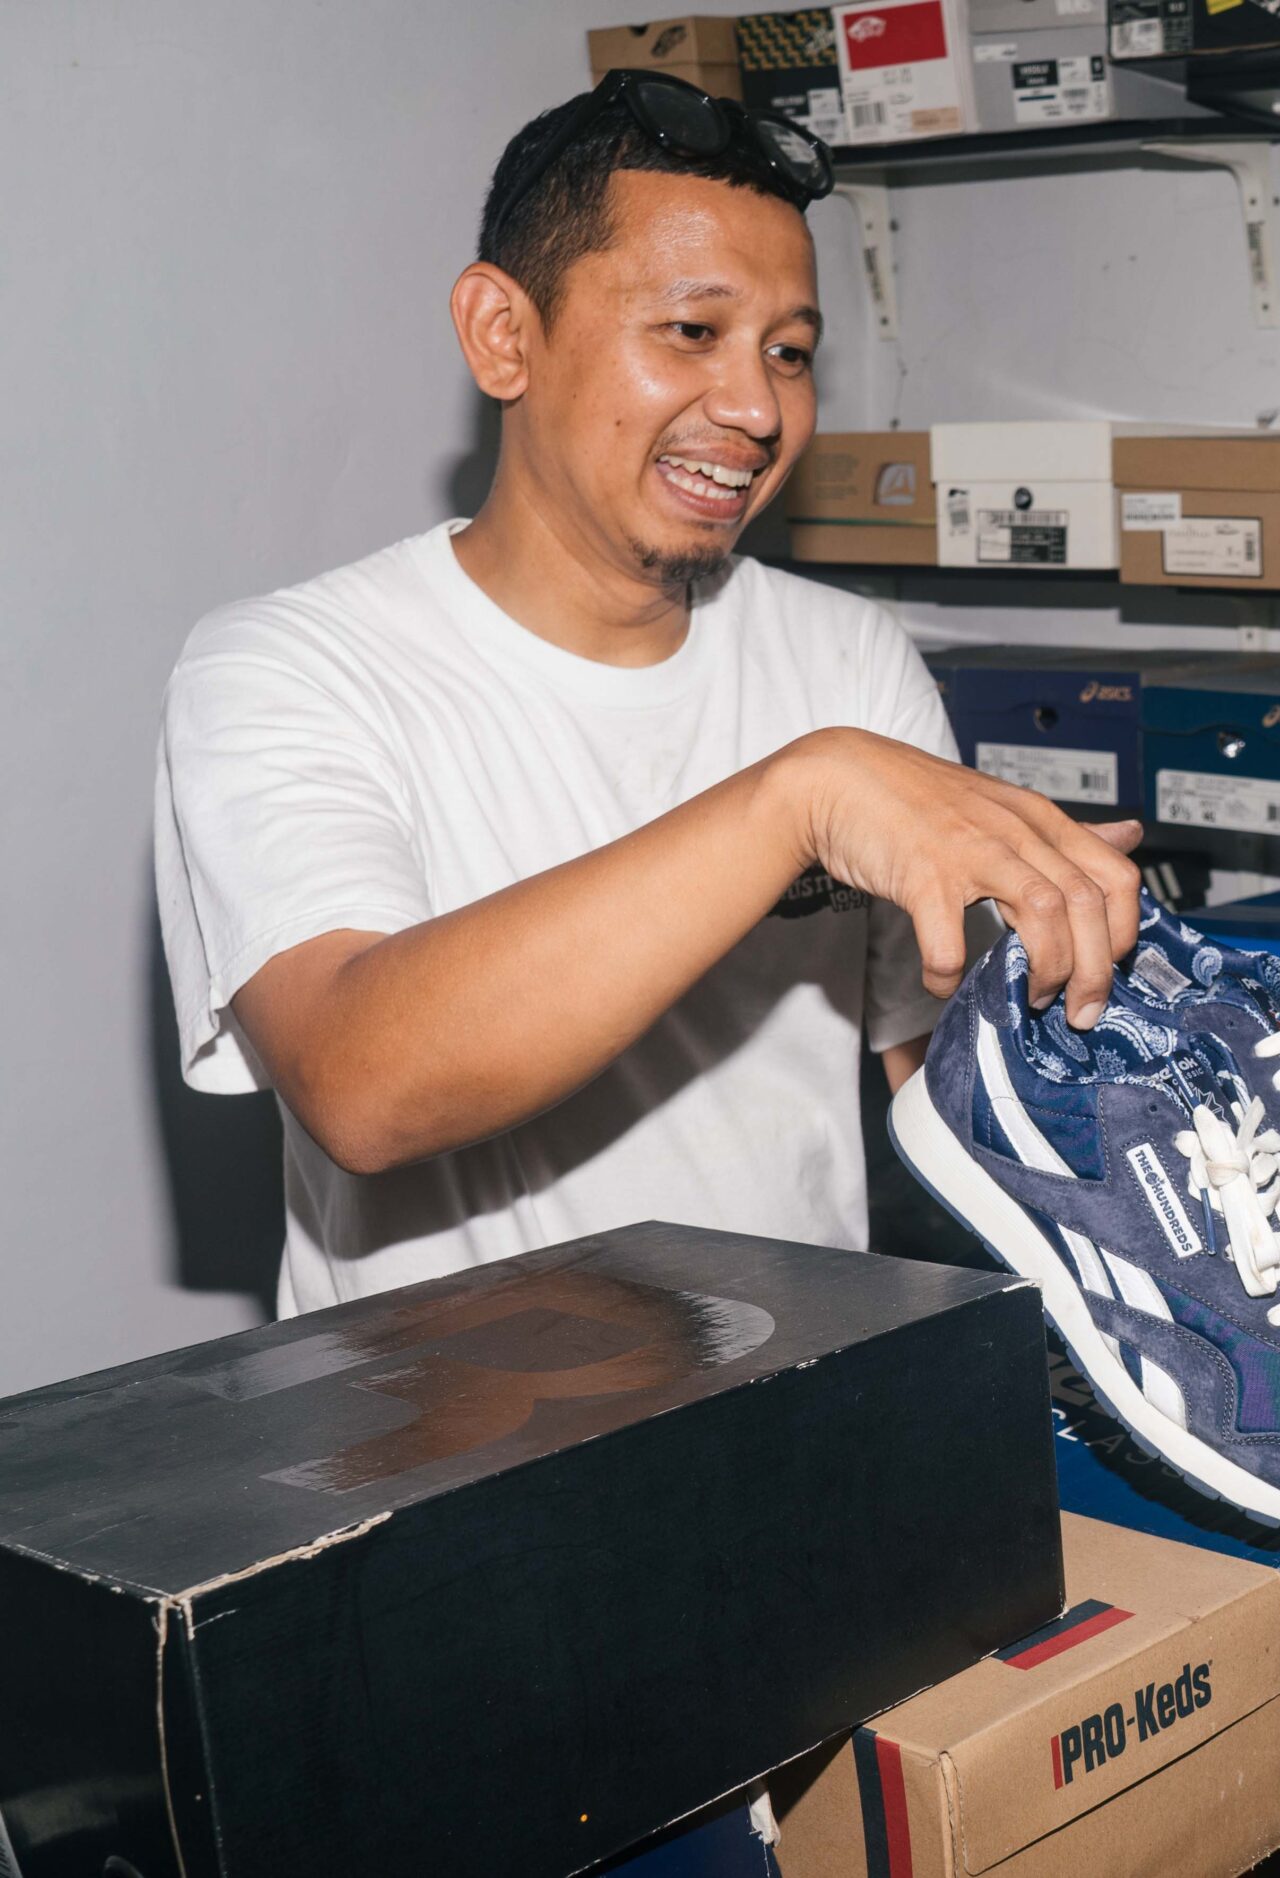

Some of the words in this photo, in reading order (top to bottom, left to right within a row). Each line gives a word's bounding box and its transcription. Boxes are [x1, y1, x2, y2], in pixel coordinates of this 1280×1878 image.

[1171, 1067, 1204, 1086] CSSIC
[1135, 1149, 1153, 1174] THE
[1151, 1178, 1193, 1252] HUNDREDS
[1061, 1664, 1212, 1786] PRO-Keds
